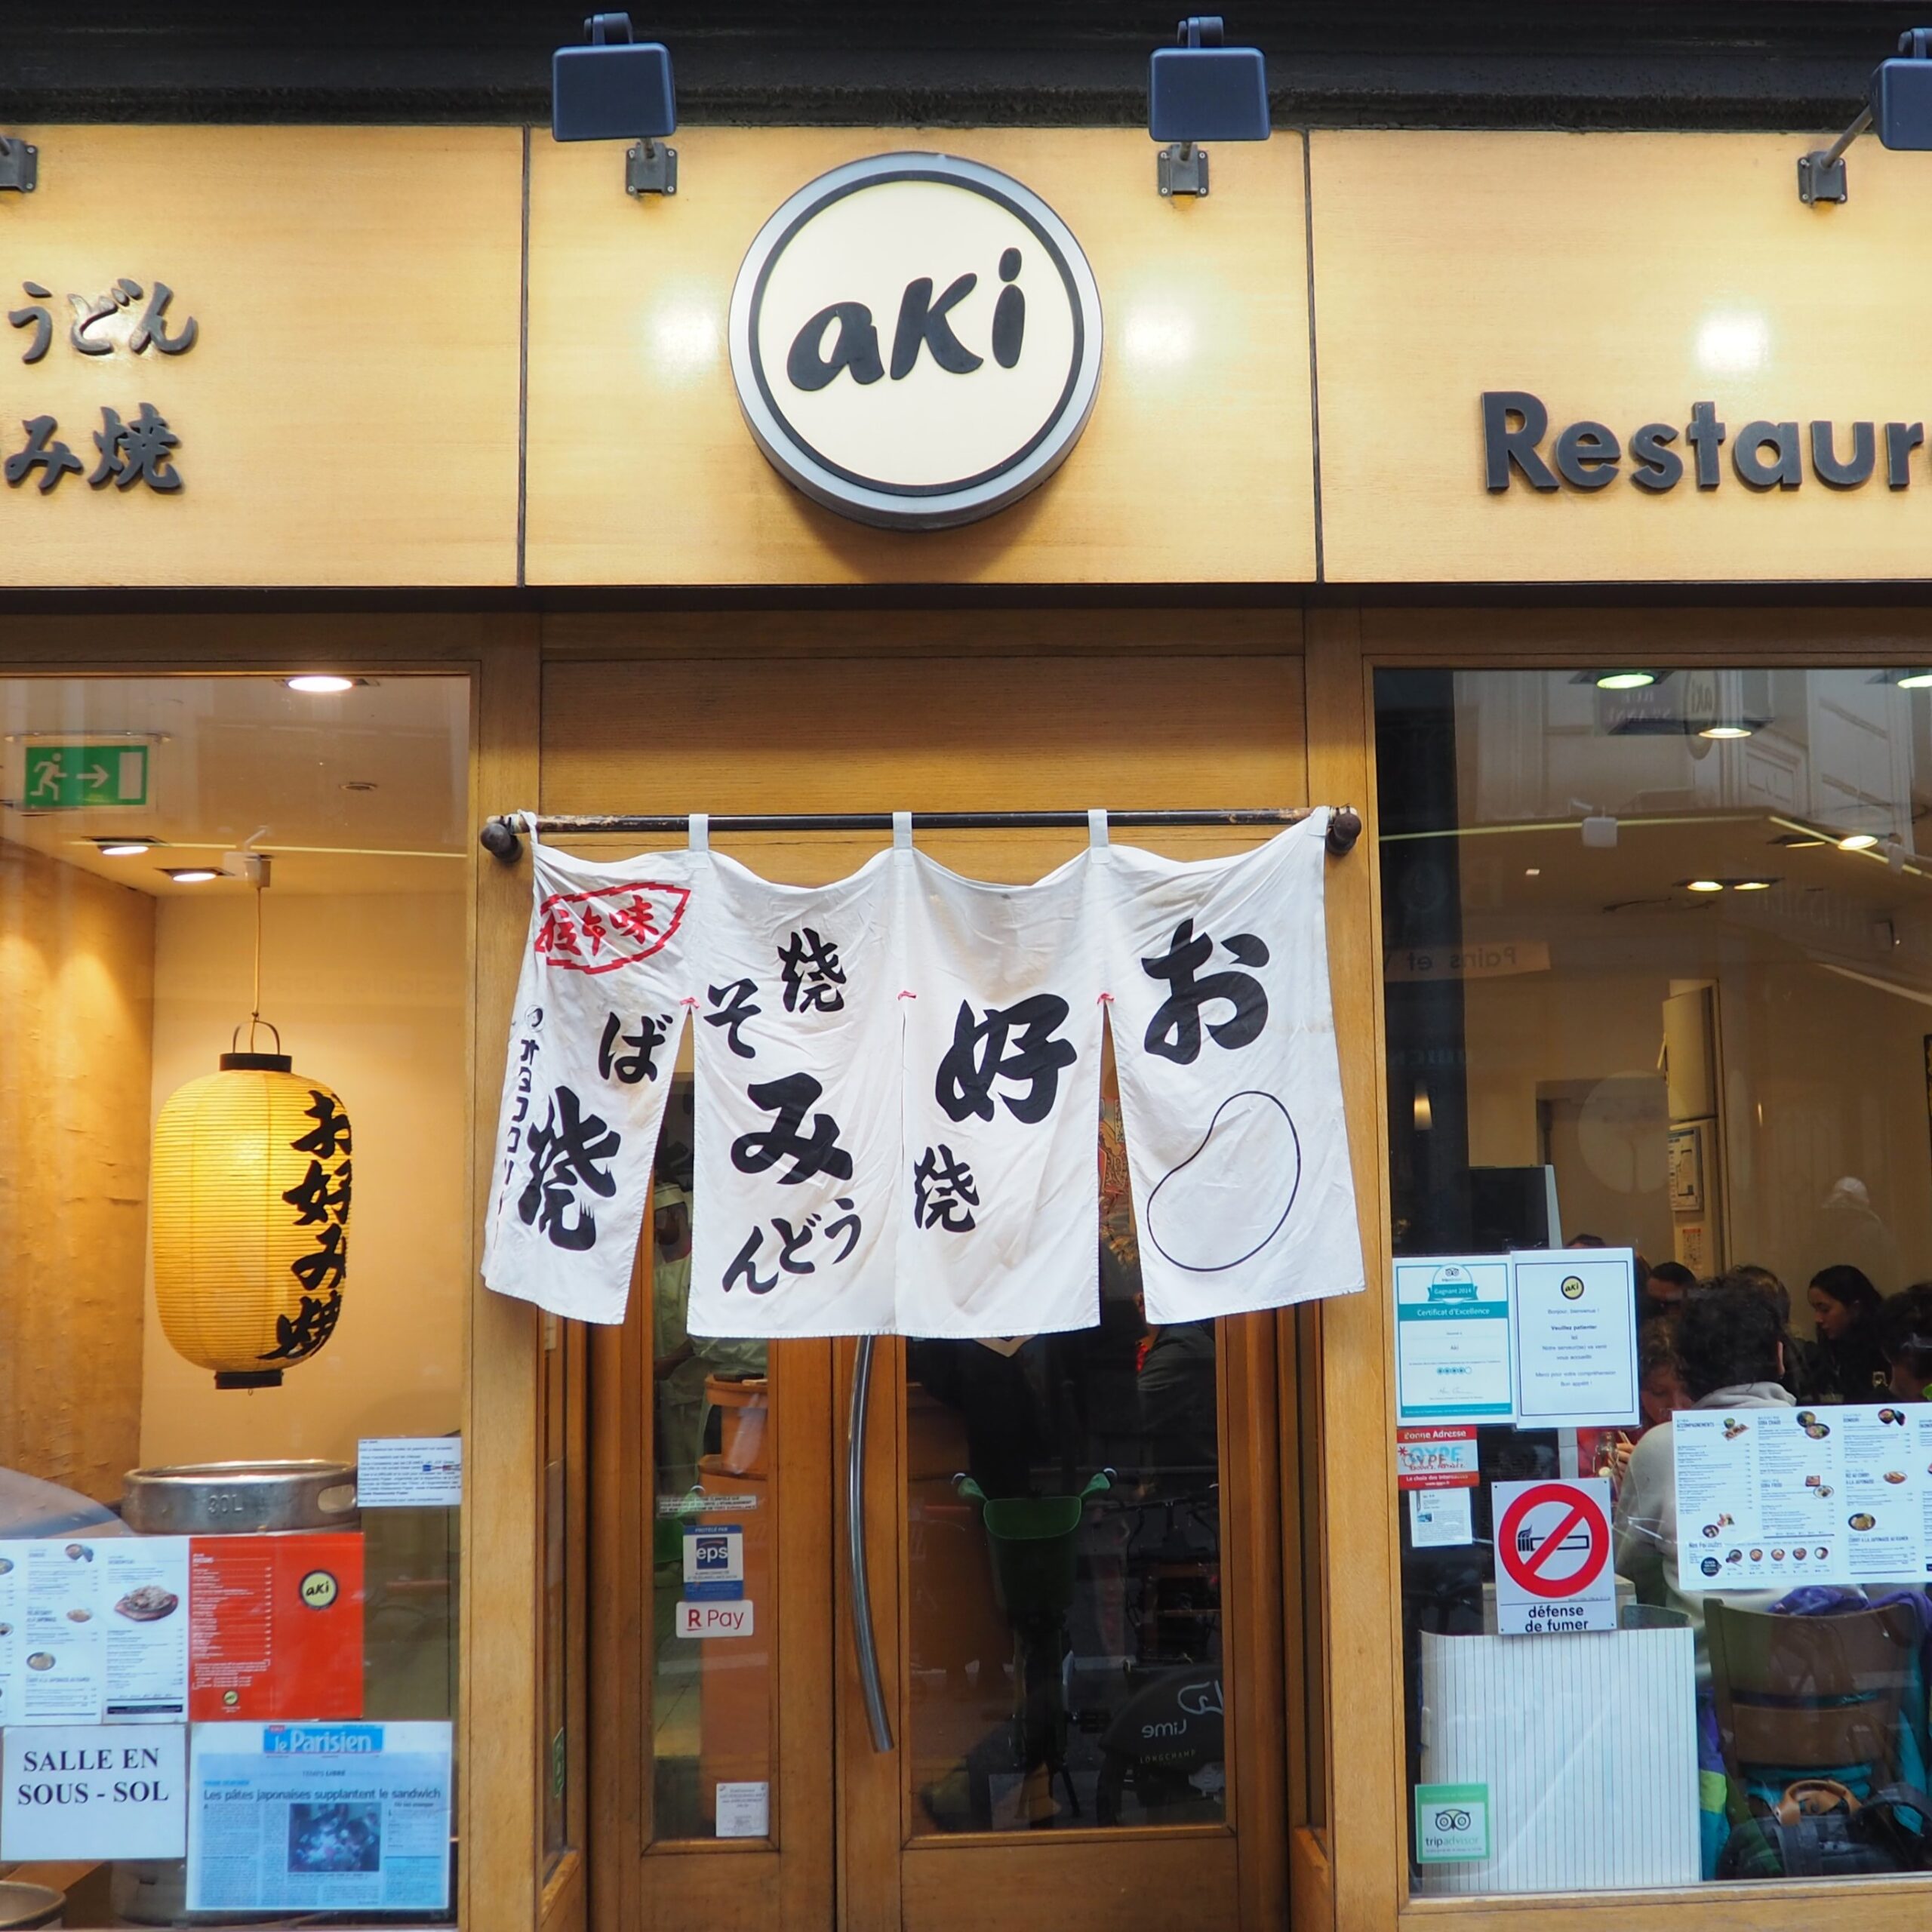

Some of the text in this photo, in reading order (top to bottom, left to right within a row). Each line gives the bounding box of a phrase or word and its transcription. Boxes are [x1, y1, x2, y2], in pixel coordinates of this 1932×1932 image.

[9, 278, 198, 364] うどん
[1481, 391, 1932, 492] Restaur
[1448, 1307, 1490, 1315] d'Excellence
[1432, 1429, 1466, 1438] Adresse
[697, 1547, 728, 1563] eps
[688, 1609, 743, 1629] R Pay
[1528, 1605, 1583, 1618] défense
[1525, 1619, 1589, 1632] de fumer
[275, 1730, 371, 1752] le Parisien
[23, 1748, 159, 1772] SALLE EN
[204, 1786, 441, 1802] Les pâtes japonaises supplantent le sandwich
[1426, 1836, 1478, 1847] tripadvisor
